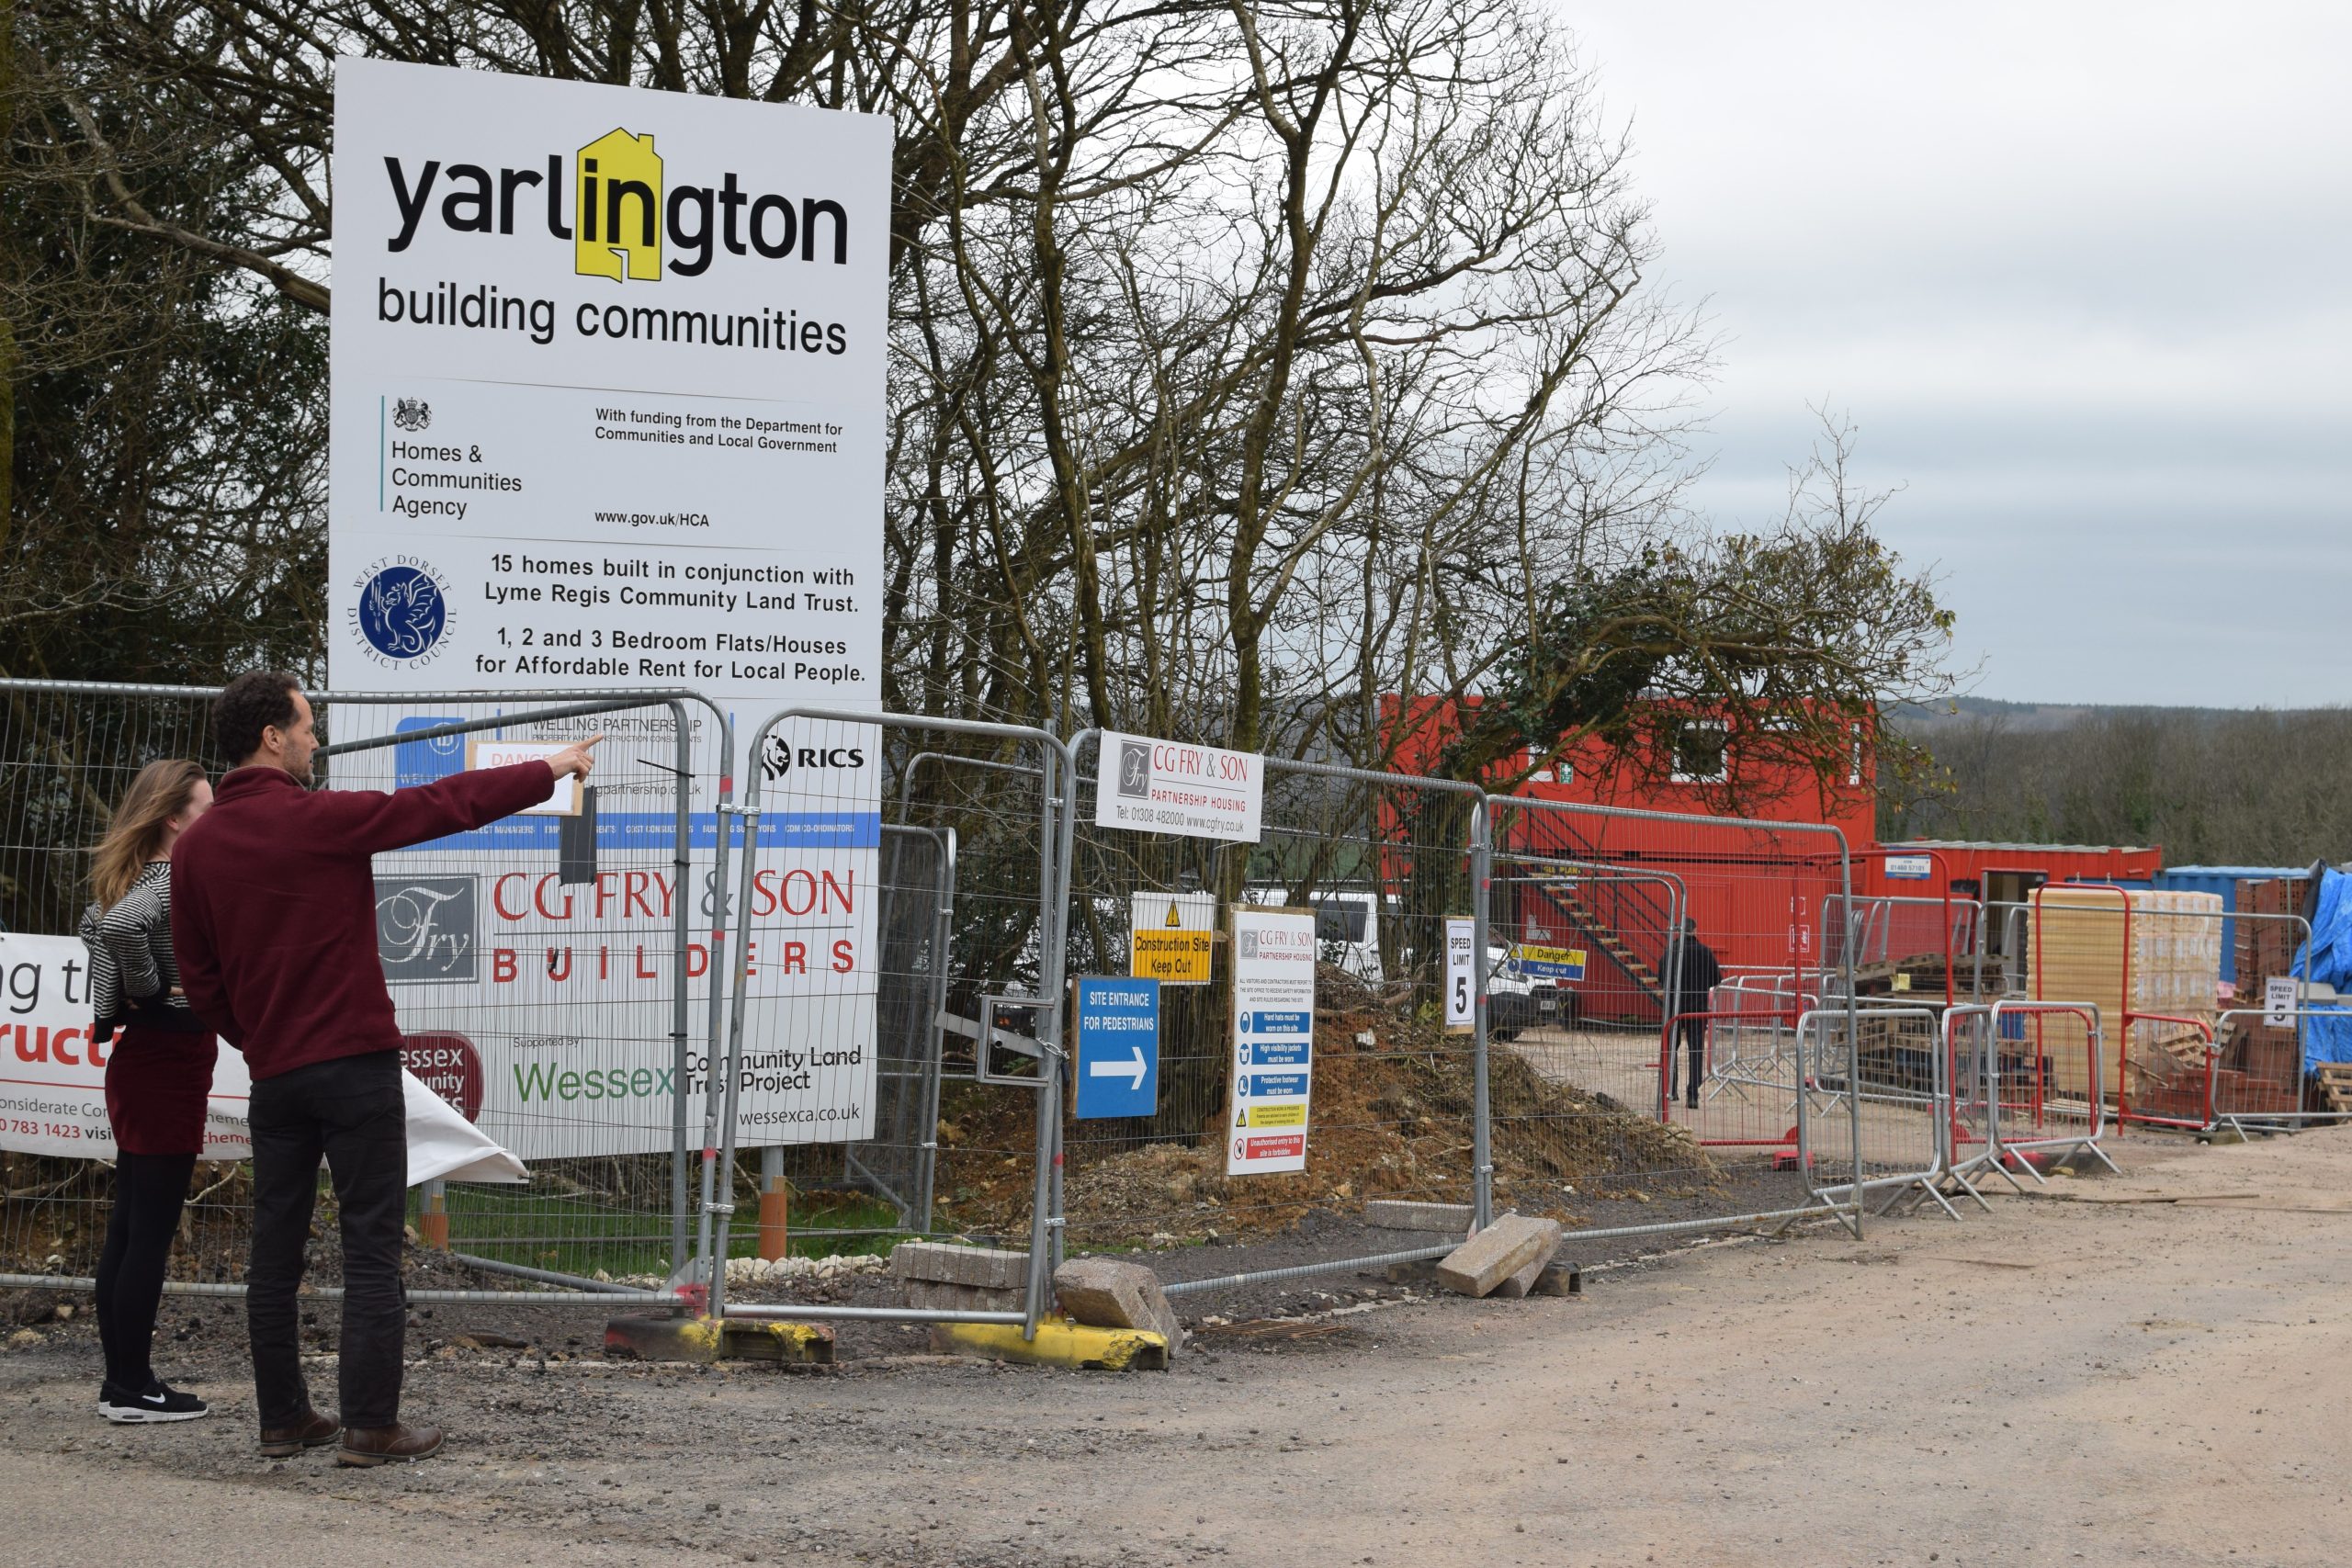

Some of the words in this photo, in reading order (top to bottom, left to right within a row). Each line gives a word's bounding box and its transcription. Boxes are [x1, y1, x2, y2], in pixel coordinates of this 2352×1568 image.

[383, 154, 848, 276] yarlington
[378, 277, 554, 344] building
[576, 302, 847, 355] communities
[596, 407, 626, 422] With
[630, 410, 682, 428] funding
[686, 413, 717, 428] from
[721, 416, 741, 429] the
[746, 418, 821, 434] Department
[825, 423, 843, 435] for
[595, 426, 684, 444] Communities
[689, 434, 714, 446] and
[718, 434, 753, 448] Local
[758, 436, 837, 453] Government
[391, 441, 462, 462] Homes
[469, 445, 482, 463] &
[391, 468, 522, 491] Communities
[392, 495, 468, 520] Agency
[595, 512, 709, 527] www.gov.uk/HCA
[353, 557, 388, 589] WEST
[397, 554, 452, 592] DORSET
[491, 554, 514, 572] 15
[522, 556, 594, 576] homes
[603, 558, 650, 579] built
[658, 561, 676, 579] in
[684, 563, 805, 585] conjunction
[813, 568, 854, 586] with
[484, 581, 542, 604] Lyme
[551, 585, 610, 607] Regis
[619, 587, 737, 612] Community
[746, 591, 797, 611] Land
[807, 593, 859, 614] Trust.
[347, 607, 401, 671] DISTRICT
[410, 608, 458, 671] COUNCIL
[497, 627, 513, 649] 1,
[522, 628, 534, 647] 2
[543, 629, 582, 649] and
[591, 630, 604, 649] 3
[612, 631, 707, 652] Bedroom
[716, 634, 847, 655] Flats/Houses
[476, 654, 506, 674] for
[515, 655, 629, 677] Affordable
[639, 659, 685, 678] Rent
[695, 660, 723, 679] for
[731, 660, 786, 681] Local
[795, 663, 865, 685] People.
[533, 717, 598, 731] WELLING
[603, 719, 702, 732] PARTNERSIP
[650, 735, 702, 743] CONSUNTS
[797, 749, 864, 768] RICS
[1154, 745, 1176, 773] CG
[1179, 749, 1204, 775] FRY
[1206, 752, 1216, 778] &
[1220, 755, 1248, 782] SON
[1151, 788, 1208, 808] PARTNERSHIP
[1211, 797, 1246, 812] HOUSING
[703, 825, 735, 833] BUILG
[736, 825, 775, 833] SUYORS
[786, 824, 800, 833] CDM
[802, 824, 854, 833] CO-ORDINATORS
[1116, 805, 1129, 819] Tel:
[1131, 807, 1154, 822] 01308
[1156, 810, 1185, 827] 482000
[1186, 817, 1244, 834] www.cgfry.co.uk
[493, 871, 574, 920] CG
[594, 870, 678, 919] FRY
[700, 870, 734, 918] &
[752, 868, 854, 916] SON
[1135, 936, 1190, 953] Construction
[1193, 937, 1210, 953] Site
[1260, 930, 1273, 945] CG
[1274, 931, 1289, 946] FRY
[1297, 931, 1313, 947] SON
[1451, 937, 1471, 949] SPEED
[1259, 952, 1292, 961] PARTNERSHIP
[1293, 953, 1313, 962] HOUSING
[1453, 953, 1470, 966] LIMIT
[1537, 948, 1571, 962] Danger
[1150, 958, 1172, 976] Keep
[1175, 959, 1192, 974] Out
[1537, 964, 1554, 975] Keep
[1090, 991, 1107, 1006] SITE
[1108, 992, 1149, 1007] ENTRANCE
[1455, 976, 1467, 1014] 5
[2269, 985, 2292, 993] SPEED
[2273, 1004, 2286, 1022] 5
[1084, 1017, 1101, 1031] FOR
[1102, 1017, 1154, 1032] PEDESTRIANS
[514, 1037, 563, 1049] Supported
[567, 1037, 580, 1048] By
[399, 1048, 464, 1068] essex
[810, 1044, 862, 1066] Land
[513, 1062, 677, 1102] Wessex
[741, 1071, 810, 1094] Project
[0, 1097, 77, 1116] onsiderate
[740, 1103, 860, 1125] wessexca.co.uk
[11, 1119, 39, 1134] 783
[44, 1122, 81, 1139] 1423
[85, 1126, 112, 1141] visi
